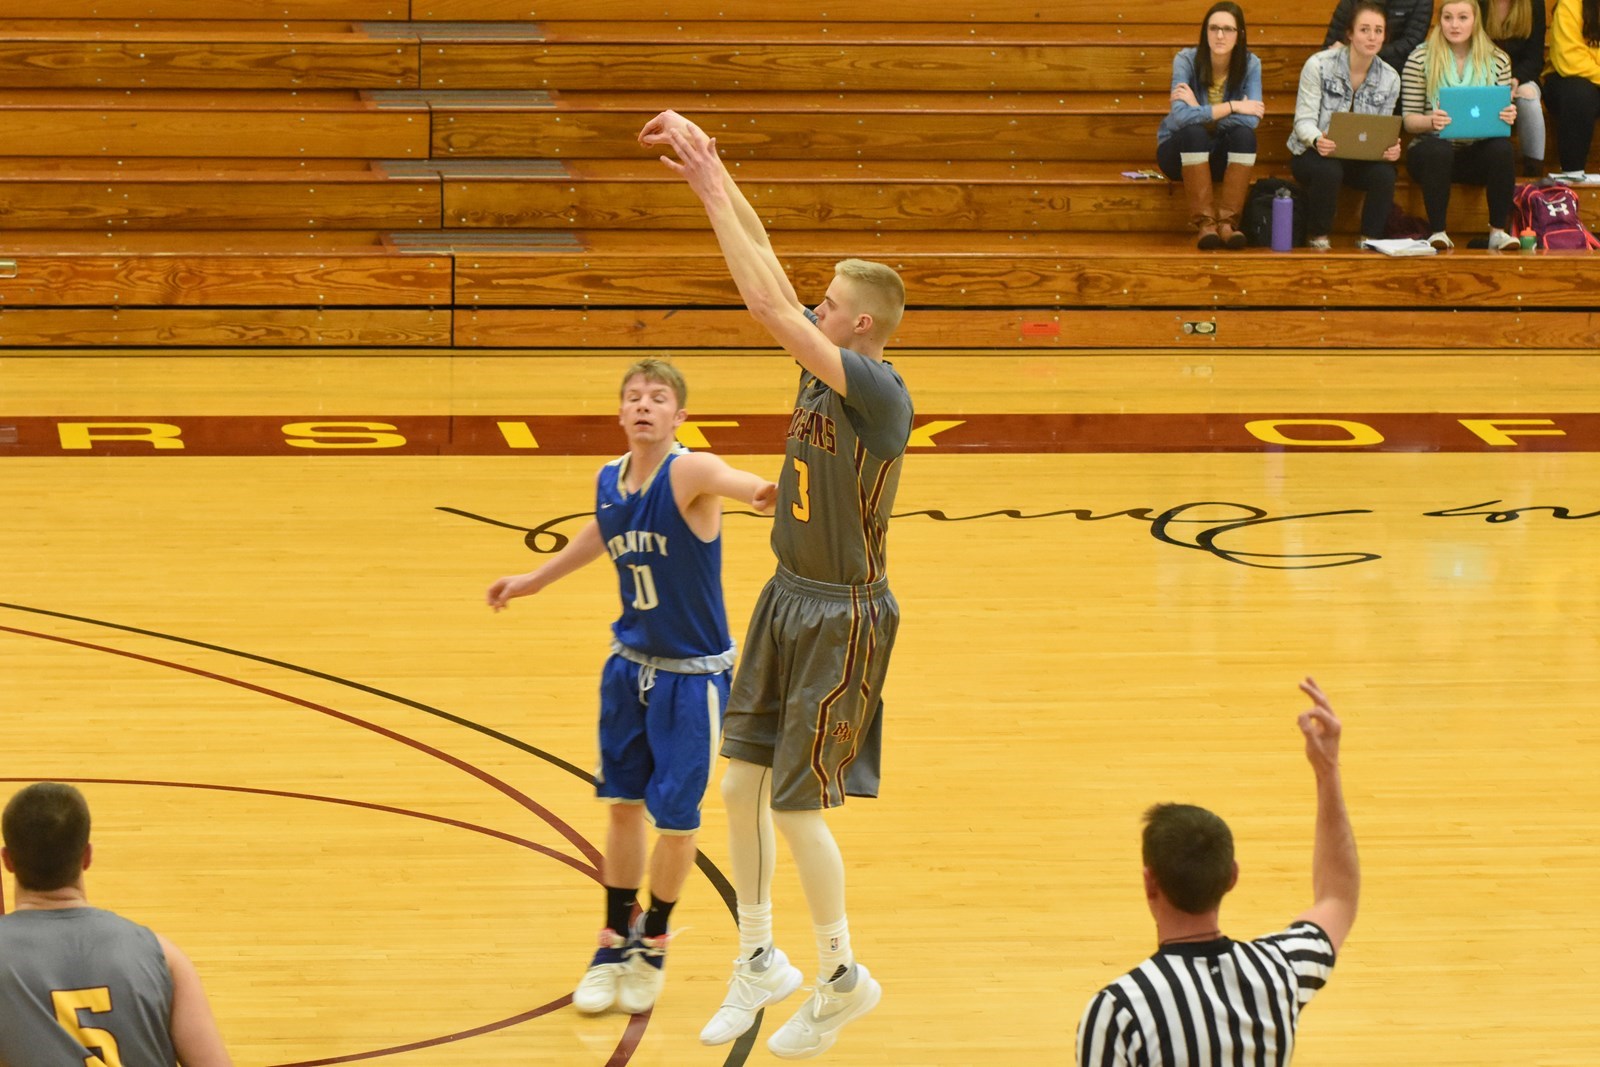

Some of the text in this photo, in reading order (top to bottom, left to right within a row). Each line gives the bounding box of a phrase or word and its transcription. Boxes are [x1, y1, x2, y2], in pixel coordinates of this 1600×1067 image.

[1244, 419, 1567, 447] OF
[791, 456, 811, 524] 3
[51, 985, 124, 1067] 5
